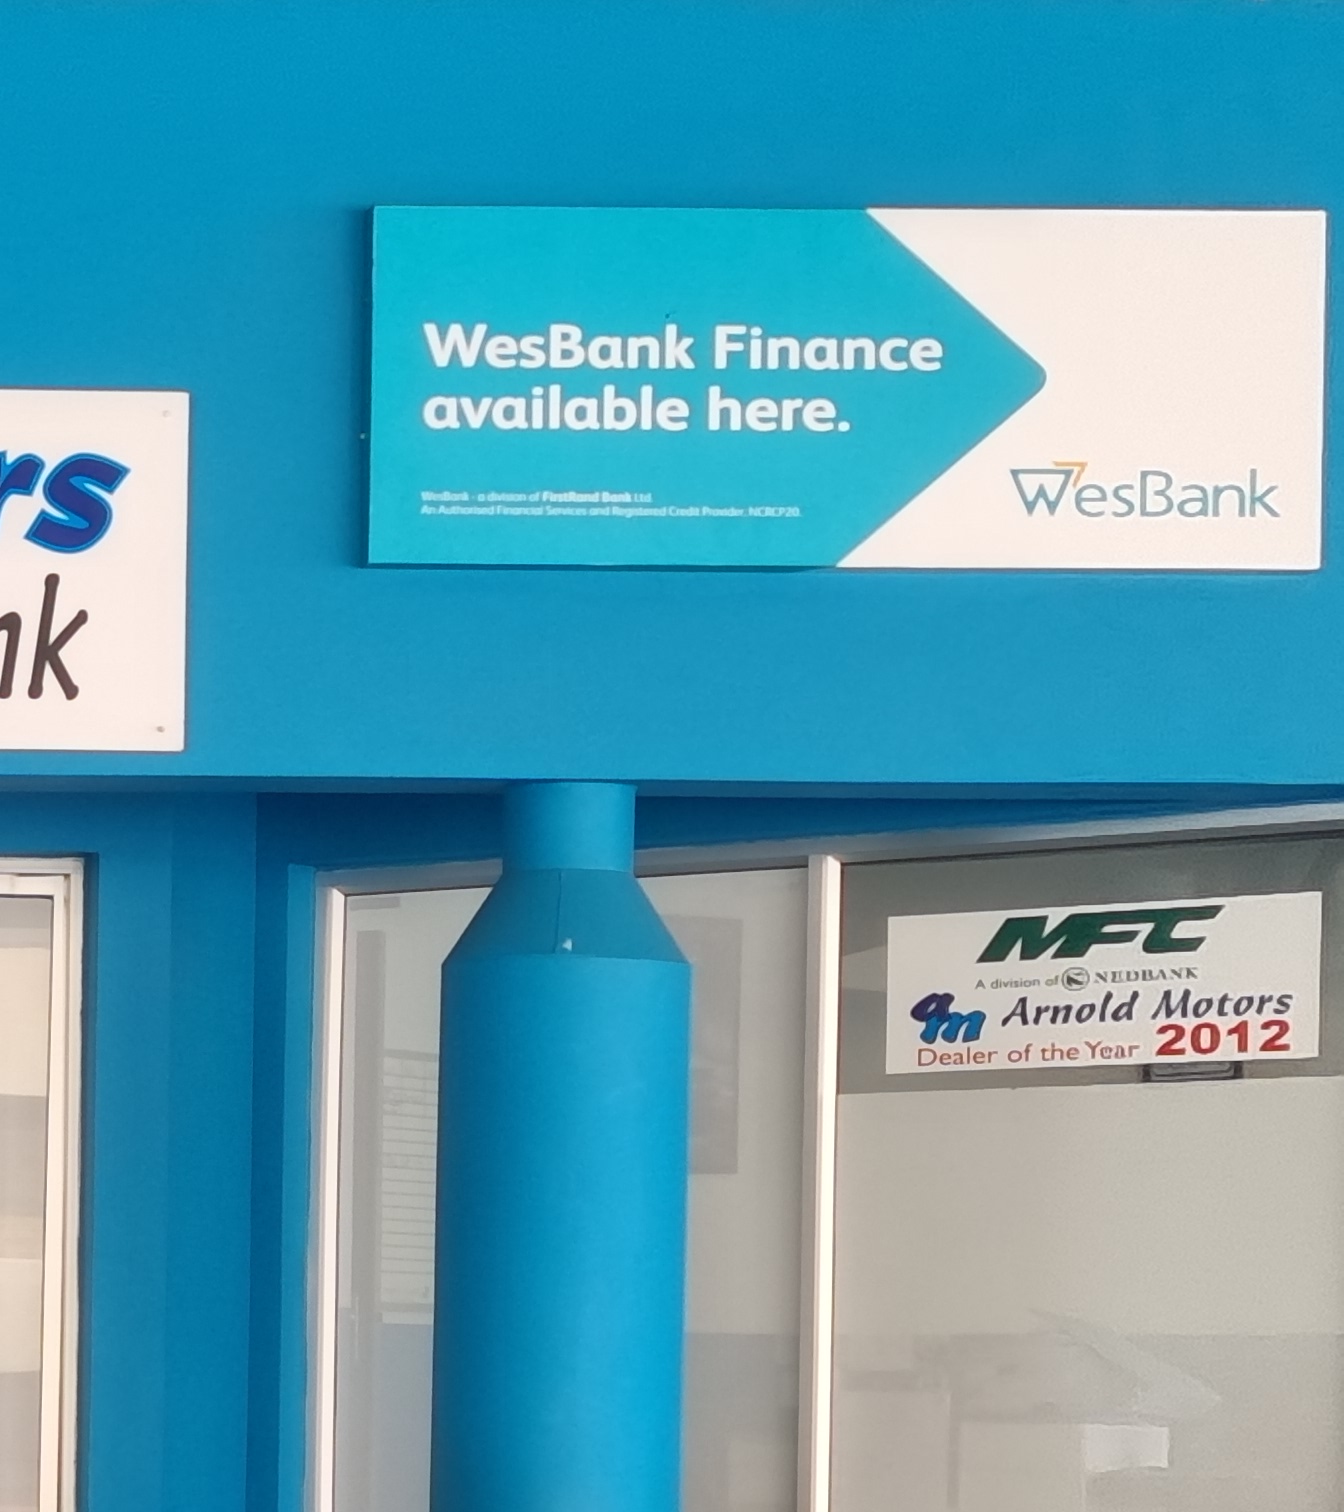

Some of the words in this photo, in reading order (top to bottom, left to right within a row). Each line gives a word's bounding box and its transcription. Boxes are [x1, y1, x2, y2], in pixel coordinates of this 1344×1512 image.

[423, 323, 695, 370] WesBank
[715, 325, 944, 372] Finance
[422, 385, 690, 432] available
[708, 386, 850, 433] here.
[1009, 461, 1281, 519] WesBank
[975, 905, 1226, 963] MFC
[974, 979, 986, 990] A
[990, 978, 1041, 990] division
[1045, 975, 1059, 987] of
[1094, 967, 1199, 984] NEDBANK
[1001, 990, 1140, 1028] Arnold
[1151, 988, 1294, 1020] Motors
[917, 1045, 998, 1066] Dealer
[1007, 1043, 1034, 1063] of
[1040, 1043, 1080, 1062] the
[1084, 1039, 1140, 1060] Year
[1155, 1018, 1291, 1057] 2012
